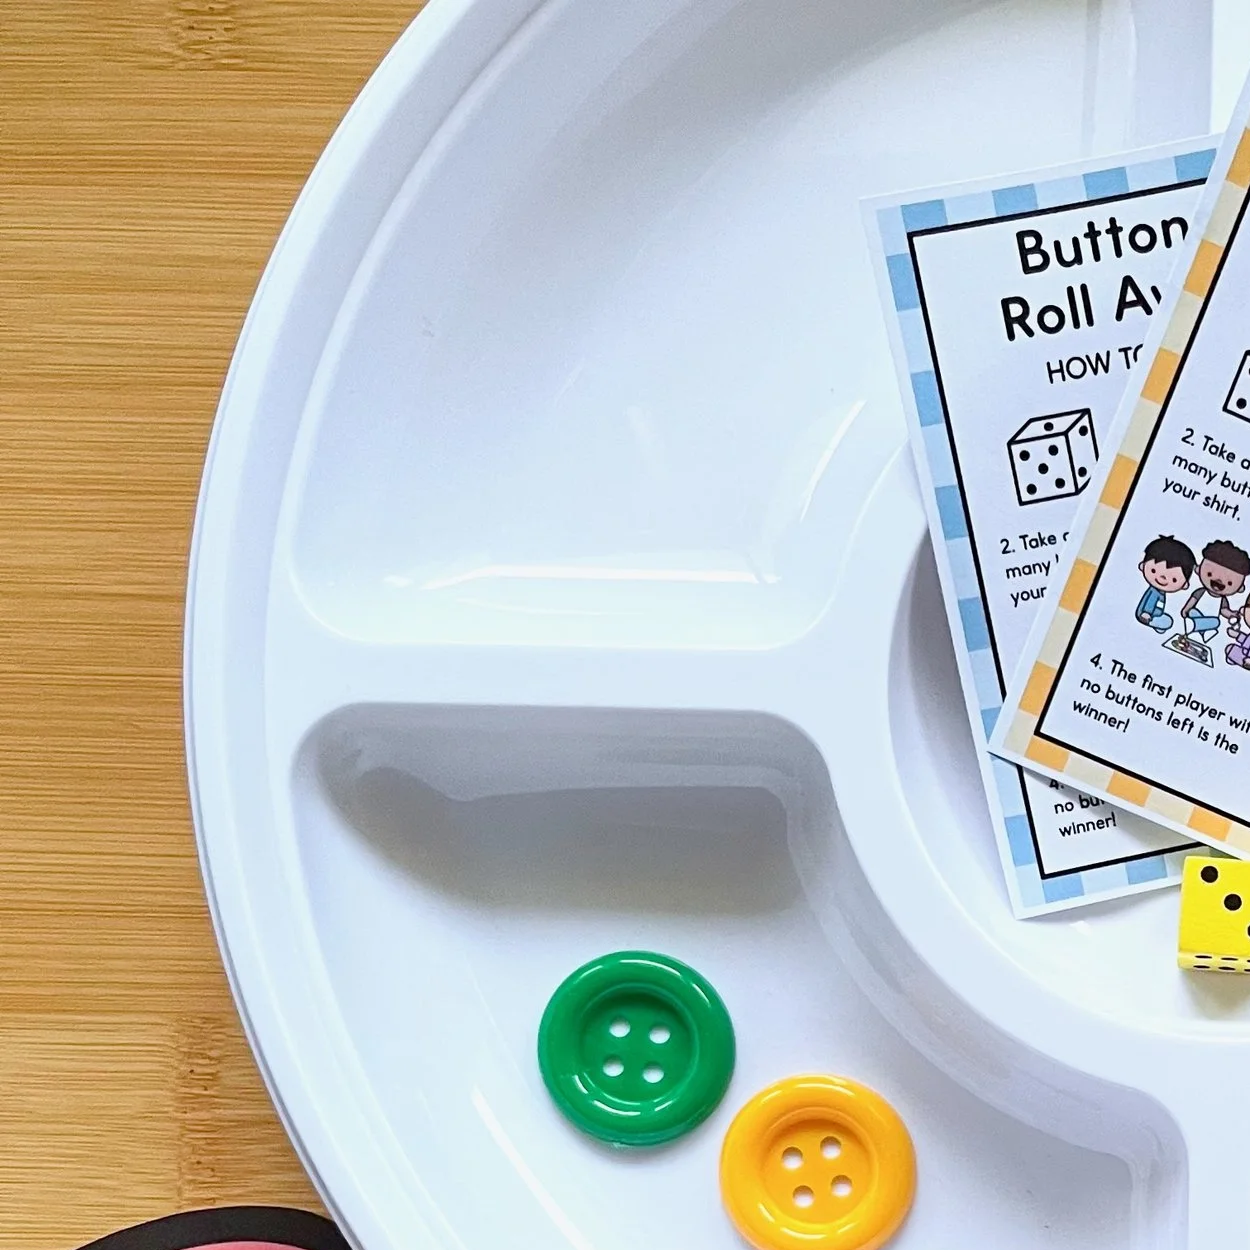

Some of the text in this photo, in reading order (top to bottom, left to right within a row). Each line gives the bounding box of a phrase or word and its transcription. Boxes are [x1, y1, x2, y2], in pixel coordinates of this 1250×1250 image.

[1000, 283, 1095, 342] Roll
[1046, 350, 1111, 384] HOW
[1180, 427, 1195, 447] 2.
[1202, 435, 1236, 463] Take
[1172, 455, 1218, 485] many
[1162, 477, 1241, 521] your shirt.
[1000, 538, 1016, 555] 2.
[1018, 532, 1057, 550] Take
[1005, 560, 1051, 579] many
[1010, 587, 1047, 608] your
[1089, 652, 1103, 670] 4.
[1110, 659, 1138, 684] The
[1140, 674, 1173, 699] first
[1174, 689, 1226, 721] player
[1072, 699, 1130, 733] winner!
[1080, 676, 1240, 754] no buttons left is the
[1054, 801, 1075, 814] no
[1058, 811, 1117, 837] winner!
